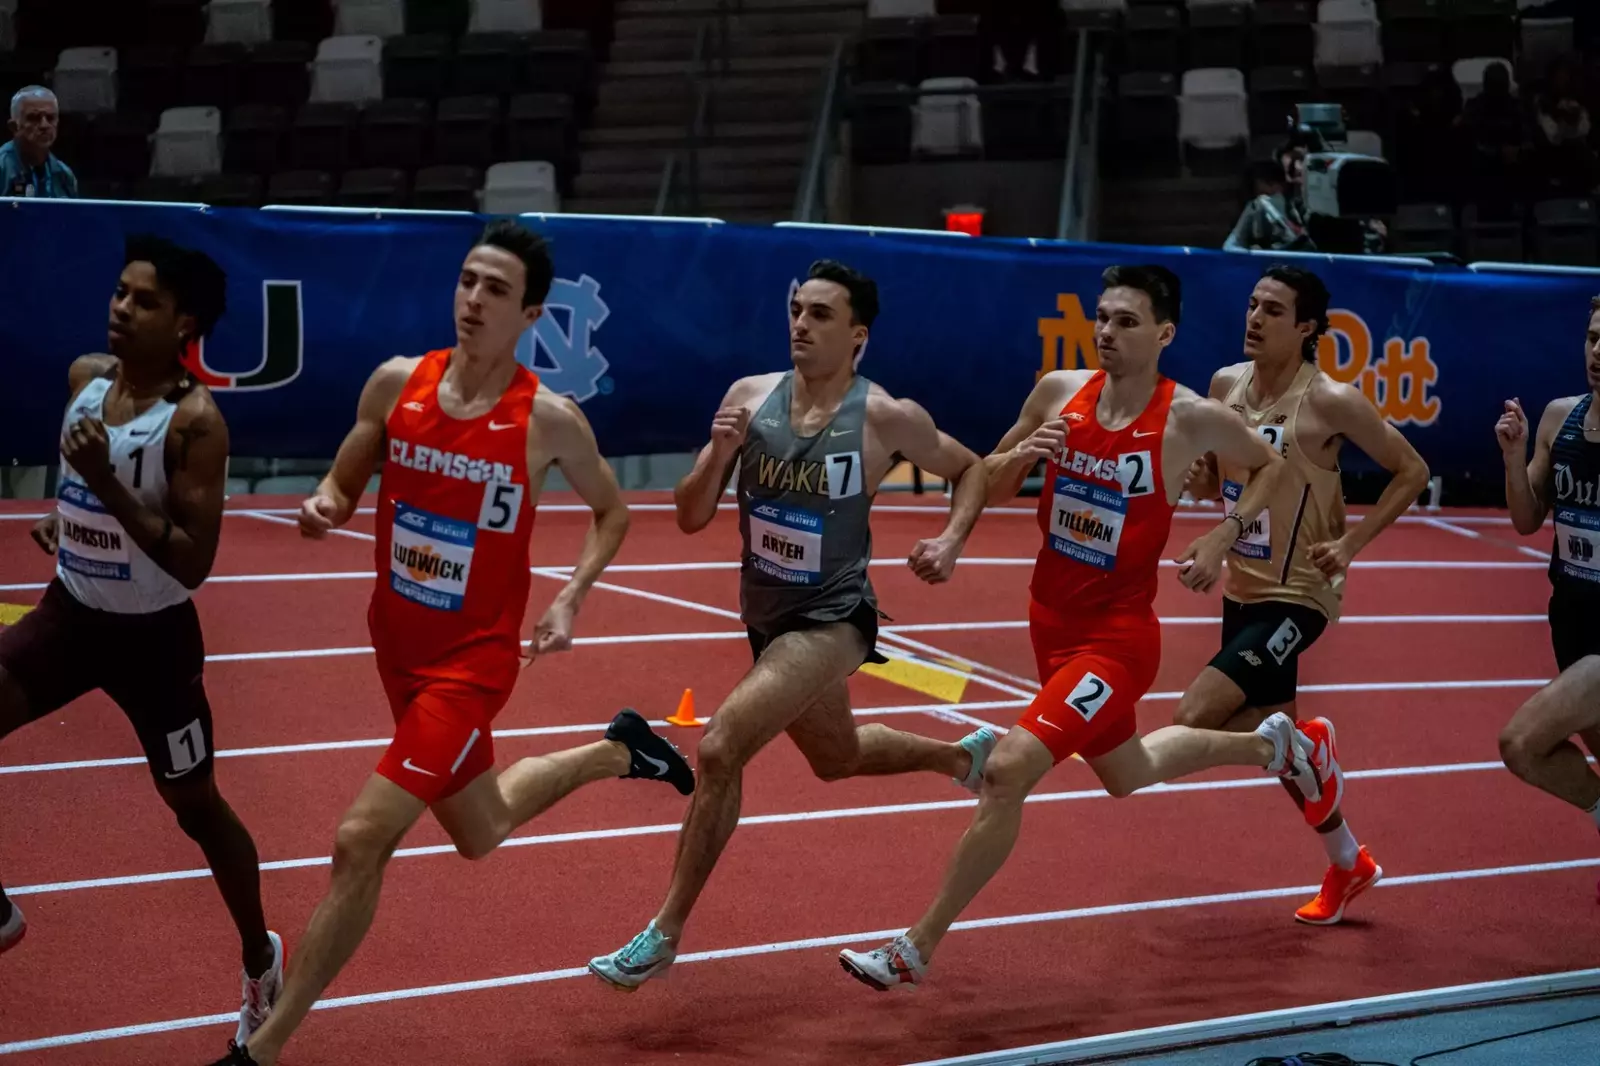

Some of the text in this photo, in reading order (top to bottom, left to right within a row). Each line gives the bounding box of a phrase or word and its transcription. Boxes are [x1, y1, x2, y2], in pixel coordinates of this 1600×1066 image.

[129, 448, 144, 488] 1
[833, 456, 853, 496] 7
[1126, 454, 1148, 495] 2
[487, 486, 515, 529] 5
[1061, 483, 1088, 496] ACC
[754, 505, 780, 519] ACC
[1059, 509, 1114, 542] TILLMAN
[394, 542, 465, 581] LUDWICK
[762, 533, 804, 560] ARYEH
[1272, 625, 1298, 657] 3
[1071, 678, 1104, 715] 2
[179, 728, 197, 764] 1
